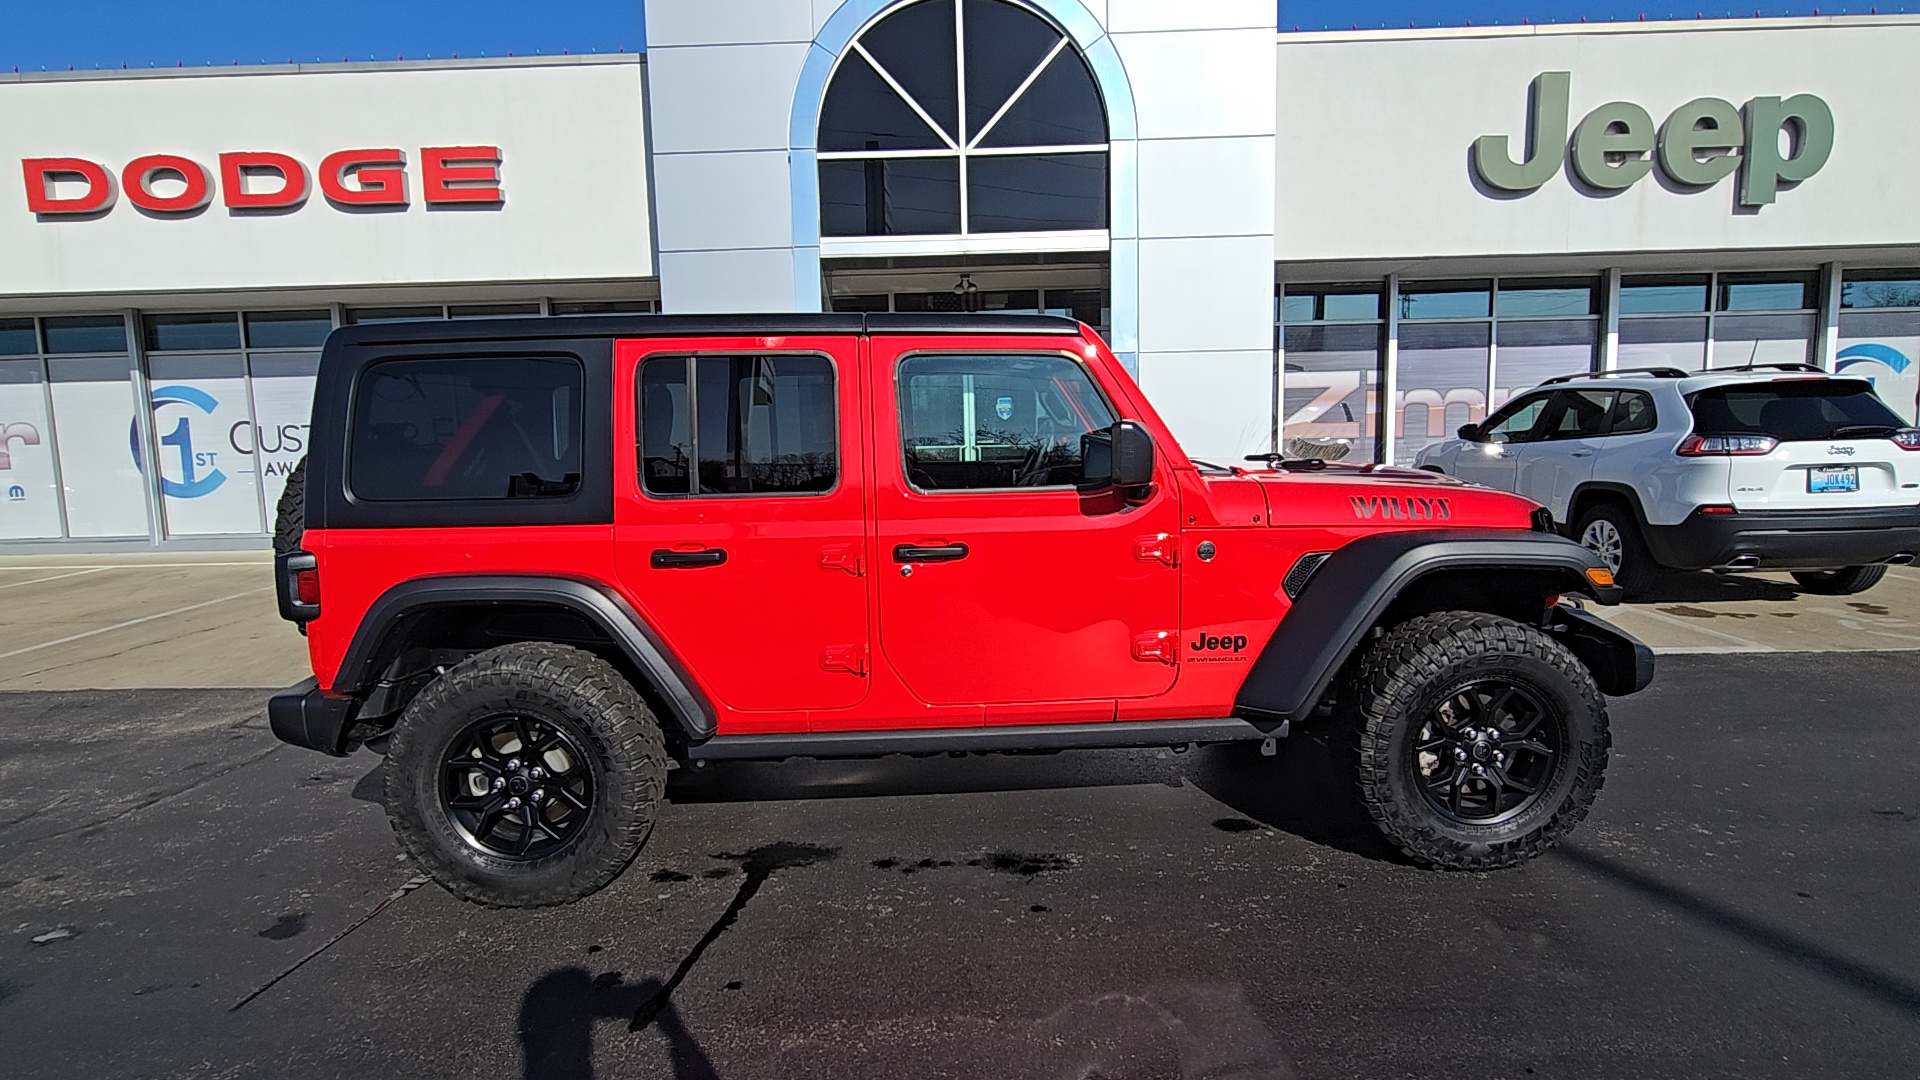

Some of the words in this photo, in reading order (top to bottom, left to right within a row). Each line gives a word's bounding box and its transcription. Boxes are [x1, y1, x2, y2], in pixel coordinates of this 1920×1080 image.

[1476, 71, 1834, 207] Jeep
[21, 146, 503, 216] DODGE
[1827, 445, 1856, 456] Jeep
[1349, 496, 1450, 519] WILLYS
[1190, 632, 1247, 653] Jeep
